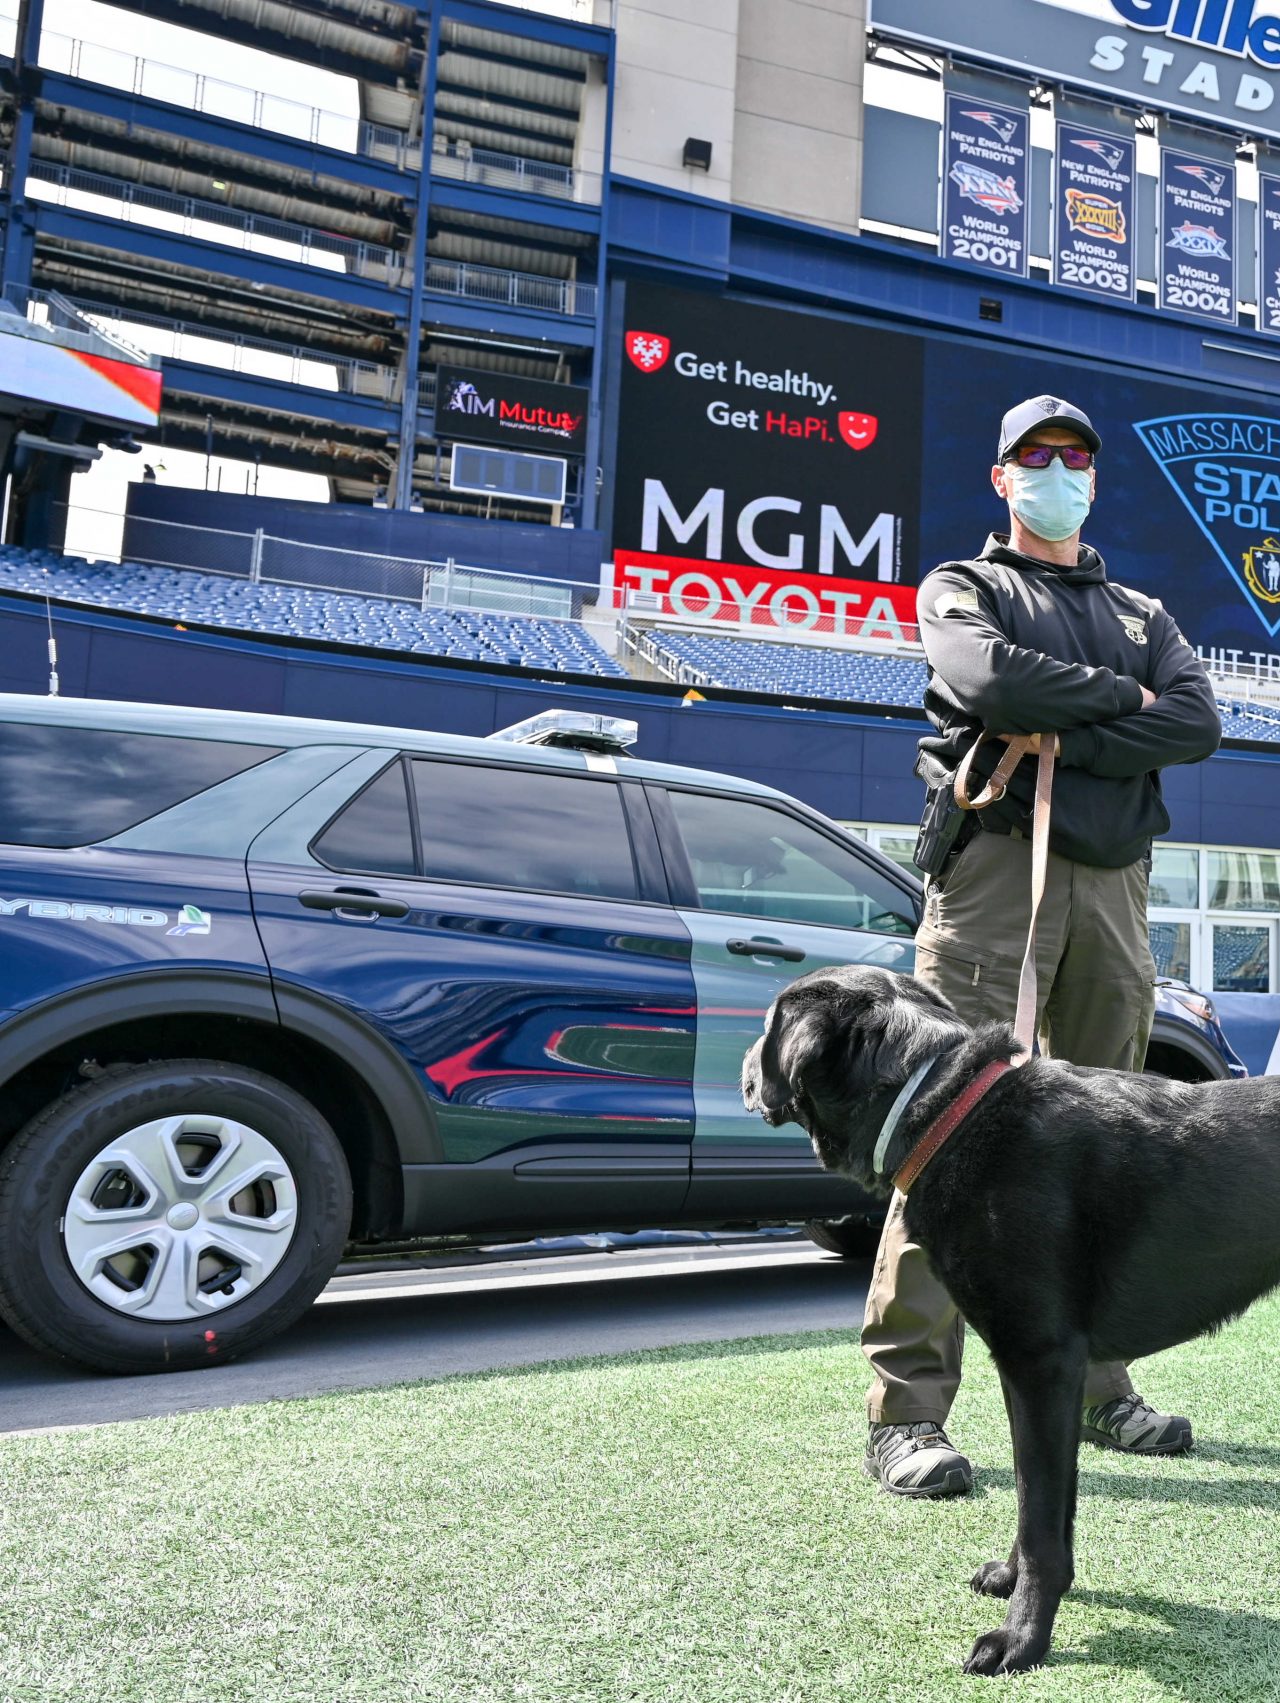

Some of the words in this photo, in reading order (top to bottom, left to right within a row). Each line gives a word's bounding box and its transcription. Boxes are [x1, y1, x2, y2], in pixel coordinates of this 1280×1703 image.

[951, 131, 975, 145] NEW
[977, 137, 1024, 157] ENGLAND
[959, 142, 1016, 166] PATRIOTS
[1061, 159, 1084, 172] NEW
[1086, 165, 1131, 184] ENGLAND
[1069, 171, 1123, 192] PATRIOTS
[1166, 184, 1188, 197] NEW
[1190, 190, 1231, 208] ENGLAND
[1173, 195, 1225, 217] PATRIOTS
[949, 225, 1022, 251] CHAMPIONS
[962, 215, 1009, 236] WORLD
[952, 239, 1017, 269] 2001
[1060, 250, 1130, 274] CHAMPIONS
[1073, 240, 1117, 260] WORLD
[1061, 263, 1128, 292] 2003
[1165, 274, 1231, 298] CHAMPIONS
[1178, 264, 1220, 283] WORLD
[1166, 286, 1231, 315] 2004
[674, 352, 727, 383] Get
[735, 360, 838, 406] healthy.
[706, 401, 759, 432] Get
[766, 410, 835, 443] HaPi.
[641, 478, 895, 583] MGM
[624, 564, 905, 642] TOYOTA
